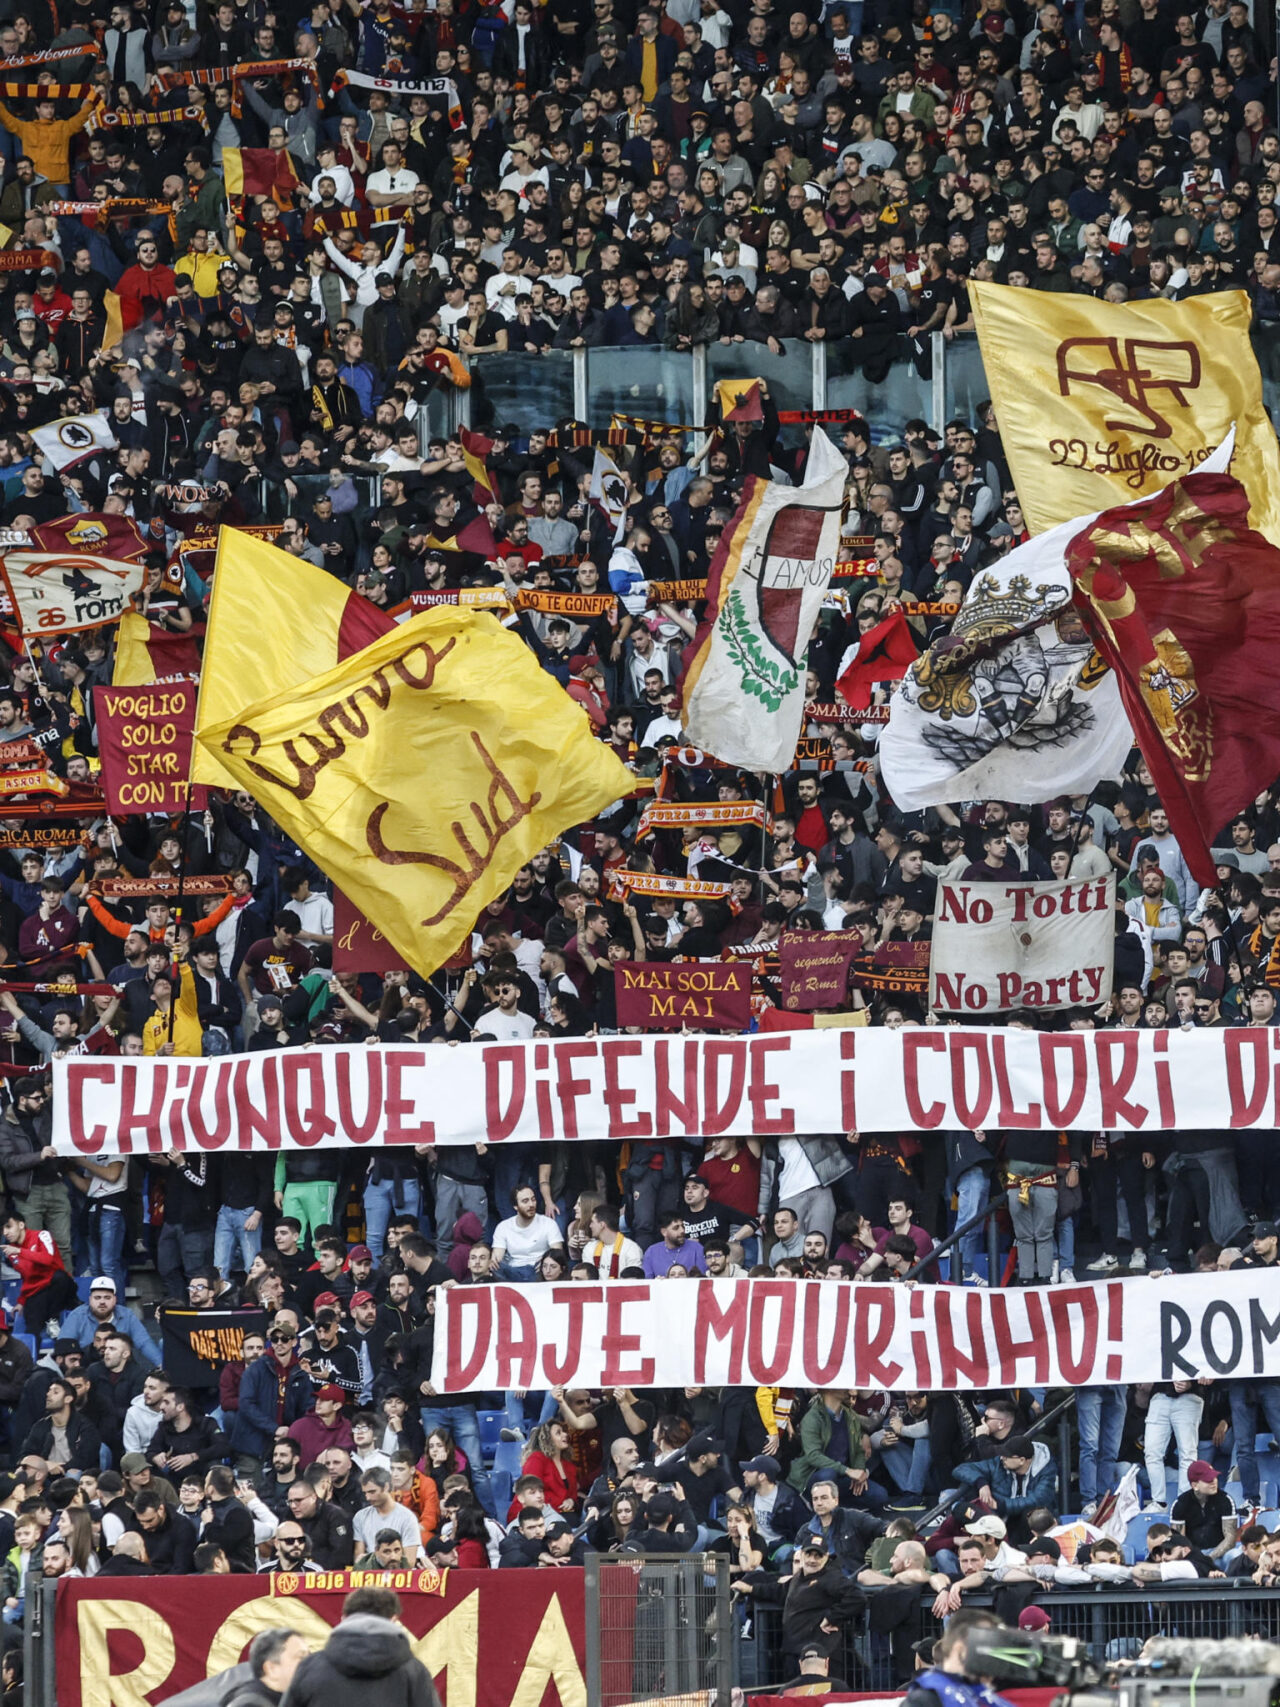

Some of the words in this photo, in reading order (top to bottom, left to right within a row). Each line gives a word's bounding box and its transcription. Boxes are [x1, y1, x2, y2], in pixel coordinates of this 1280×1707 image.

[396, 77, 446, 91] roma
[1049, 438, 1092, 468] 22
[1094, 441, 1180, 488] Luglio
[461, 591, 475, 604] TU
[547, 595, 562, 610] TE
[660, 590, 673, 600] DE
[675, 588, 706, 600] ROMA
[38, 607, 66, 628] as
[905, 602, 958, 614] LAZIO
[104, 692, 187, 719] VOGLIO
[221, 637, 456, 801] Curva
[121, 723, 177, 747] SOLO
[126, 752, 180, 776] STAR
[118, 781, 166, 805] CON
[648, 809, 691, 820] FORZA
[712, 807, 754, 818] ROMA
[35, 828, 77, 842] ROMA
[366, 731, 541, 926] Sud
[684, 880, 724, 895] ROMA
[939, 886, 993, 923] No
[1005, 877, 1108, 922] Totti
[783, 932, 804, 947] Per
[624, 968, 673, 990] MAI
[677, 970, 741, 992] SOLA
[932, 972, 988, 1010] No
[997, 967, 1104, 1008] Party
[650, 994, 715, 1018] MAI
[444, 1286, 656, 1393] DAJE
[304, 1571, 345, 1591] Daje
[349, 1569, 412, 1590] Mauro!
